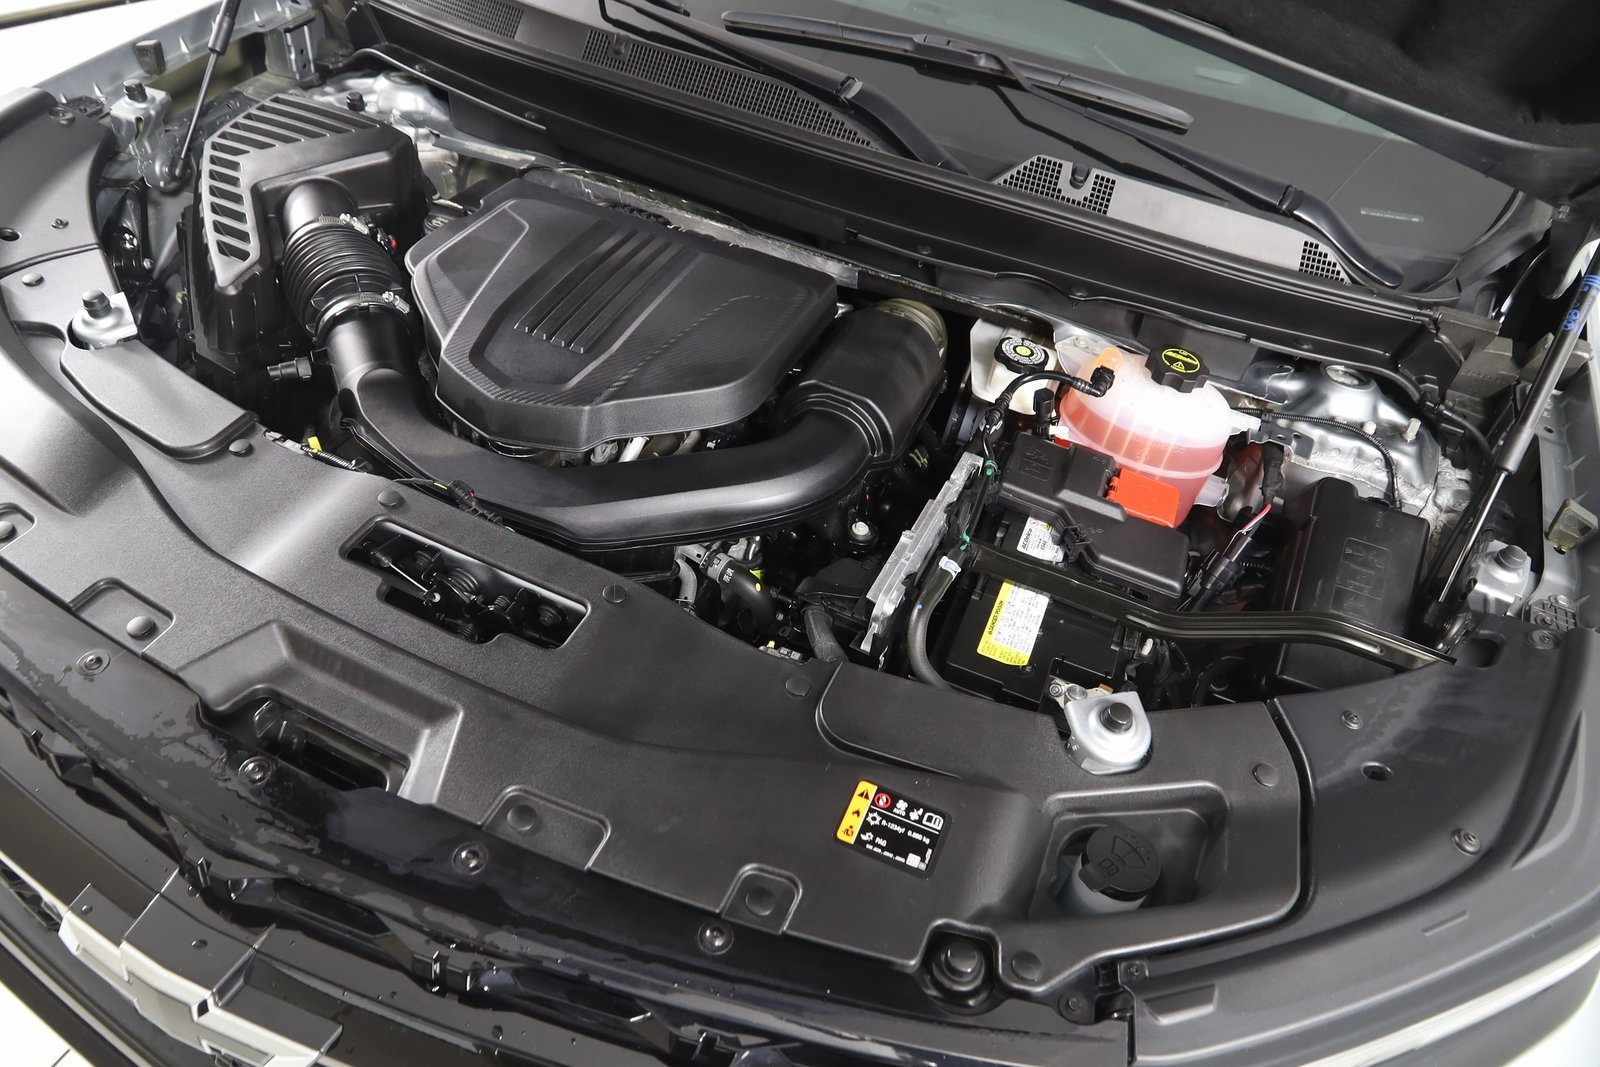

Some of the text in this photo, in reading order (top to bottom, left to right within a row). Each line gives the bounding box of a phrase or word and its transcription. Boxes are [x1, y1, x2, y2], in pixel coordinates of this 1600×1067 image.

[1021, 527, 1033, 549] ACDelco
[893, 808, 906, 816] AUTO
[881, 820, 906, 834] R-1234yf
[923, 836, 930, 845] kg
[875, 837, 887, 847] PAG
